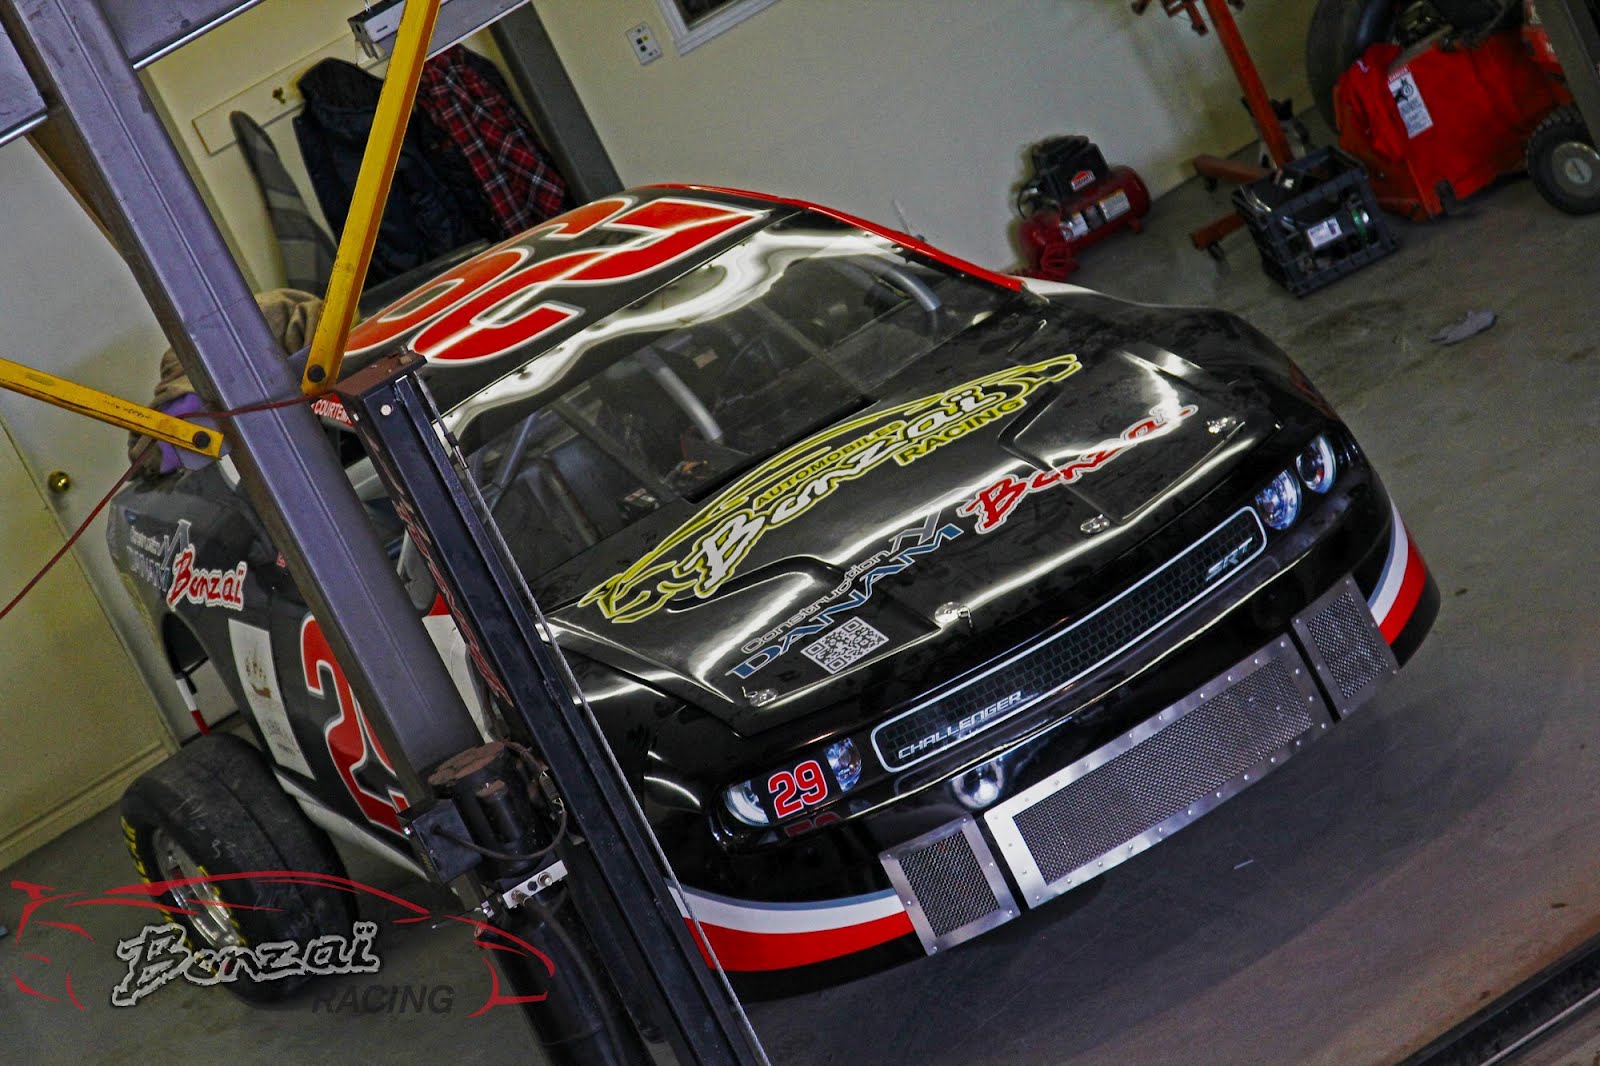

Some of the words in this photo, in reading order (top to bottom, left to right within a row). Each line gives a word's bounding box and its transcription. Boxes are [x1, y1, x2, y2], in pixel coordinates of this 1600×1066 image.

[755, 421, 904, 507] AUTOMOBILES
[898, 400, 1024, 465] RACING
[1205, 536, 1253, 582] SRT
[741, 550, 890, 655] Construction
[898, 690, 1022, 760] CHALLENGER
[767, 759, 829, 819] 29
